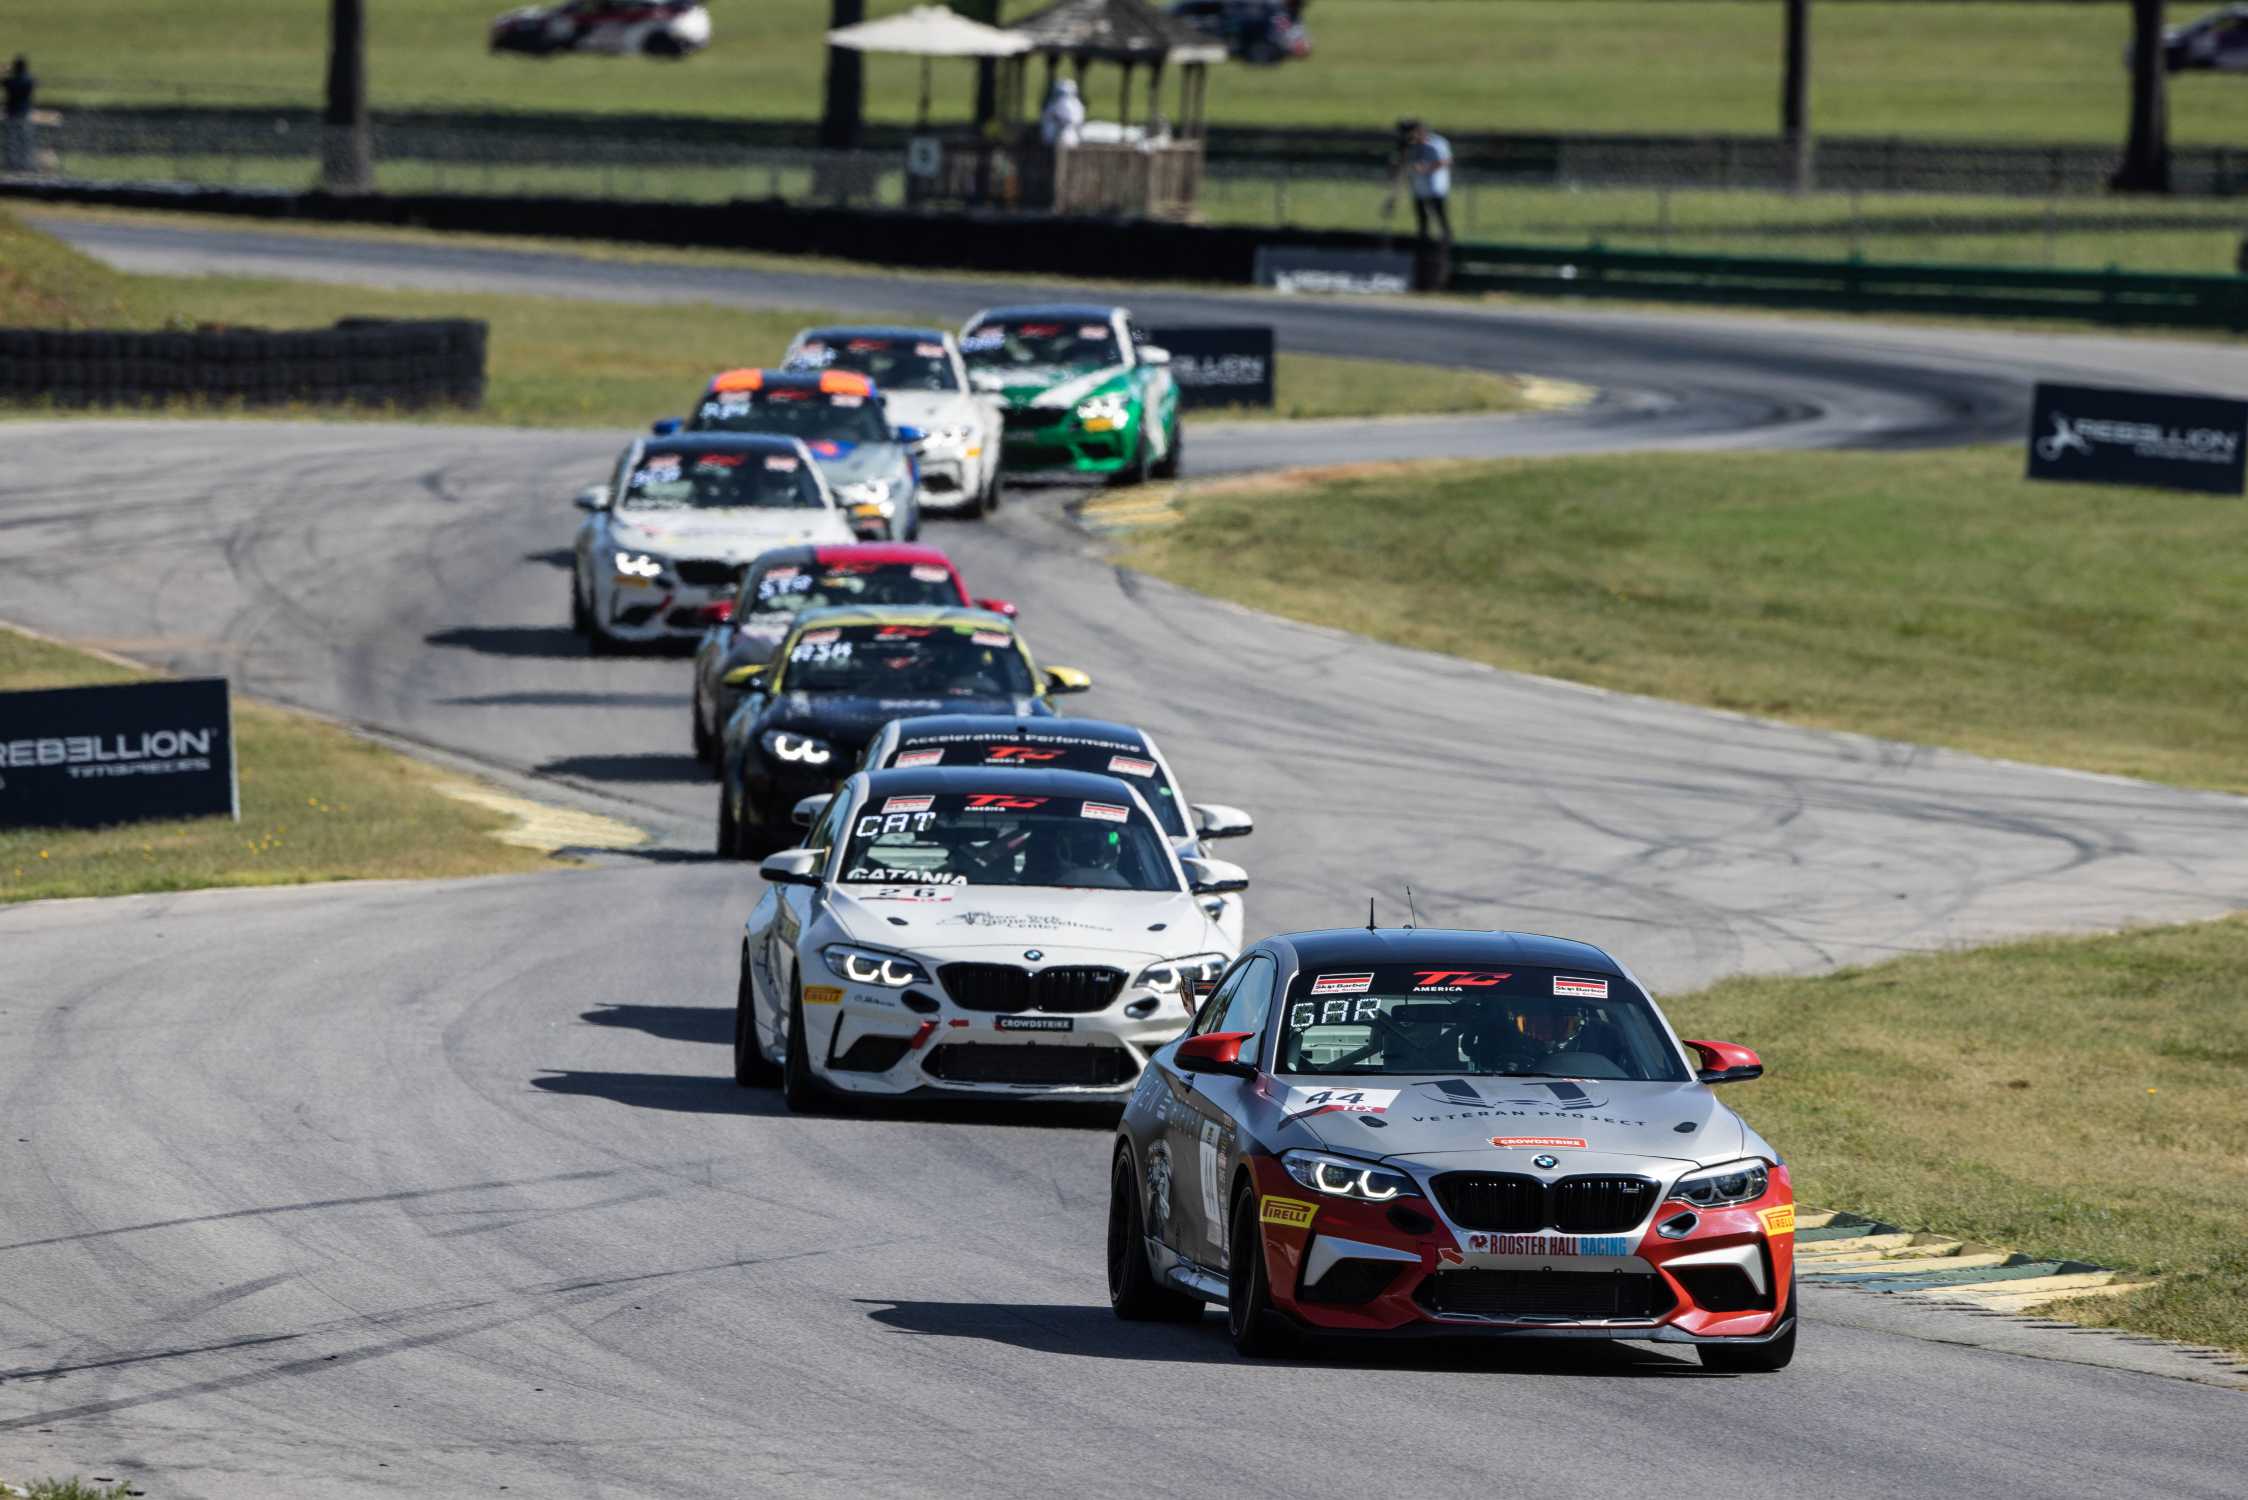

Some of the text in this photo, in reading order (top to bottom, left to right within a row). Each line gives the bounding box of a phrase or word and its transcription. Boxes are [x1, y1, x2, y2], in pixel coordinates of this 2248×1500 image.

[906, 733, 1140, 752] Accelerating Performance
[856, 811, 937, 838] CAT
[846, 867, 968, 886] CATANIA
[1290, 998, 1382, 1028] GAR
[1000, 1020, 1070, 1029] CROWDSTRIKE
[1305, 1091, 1364, 1104] 44
[1412, 1110, 1649, 1127] VETERAN PROJECT
[1500, 1138, 1581, 1146] CROWDSTRIKE
[1263, 1200, 1312, 1222] PIRELLI
[1489, 1235, 1627, 1257] ROOSTER HALL RACING
